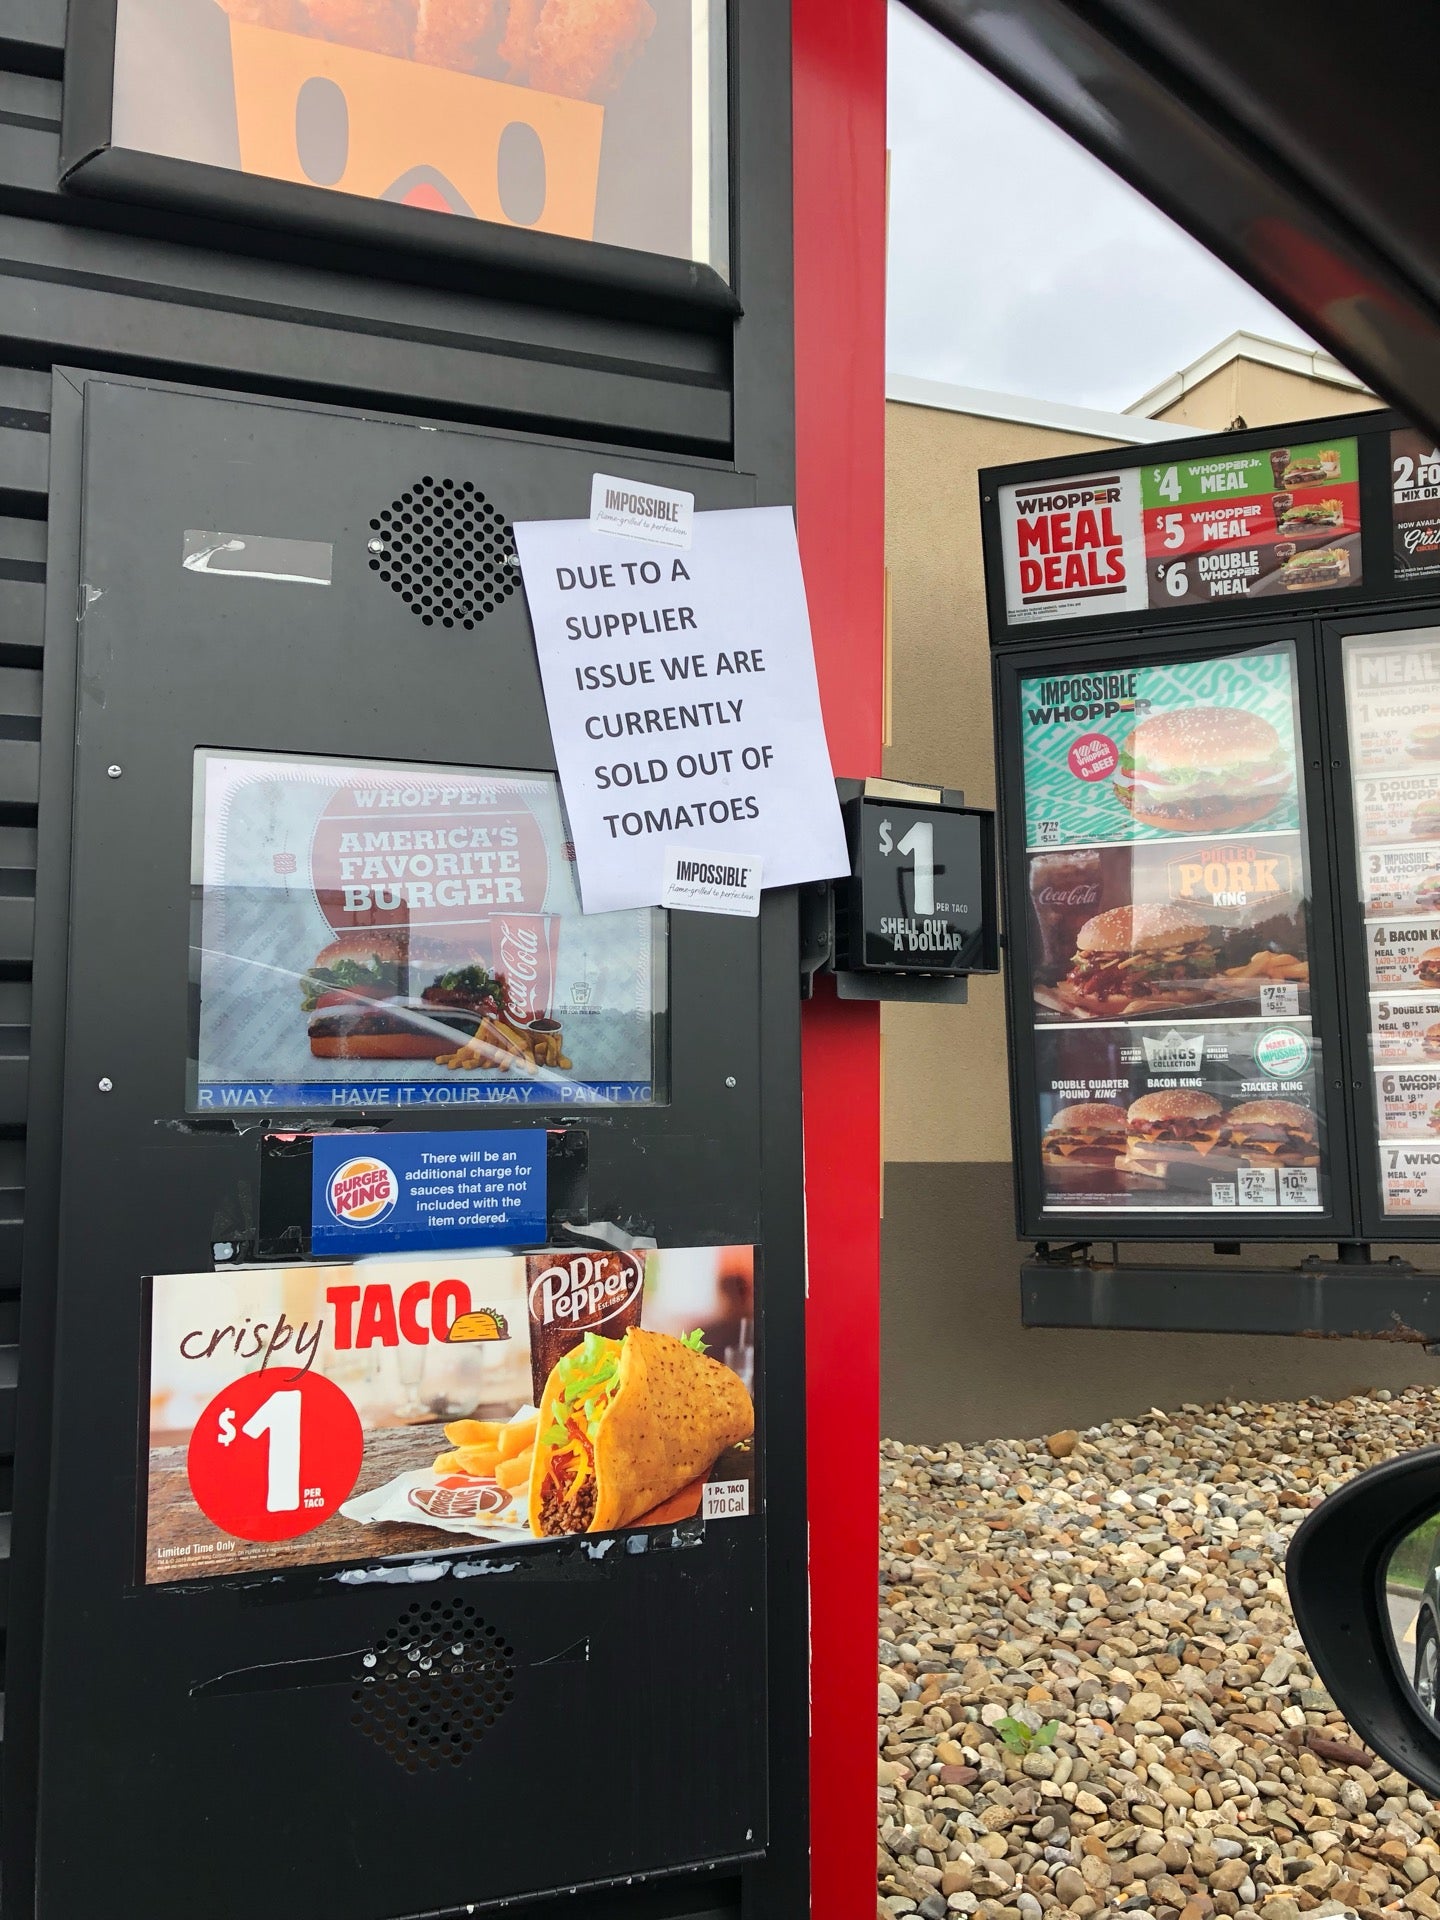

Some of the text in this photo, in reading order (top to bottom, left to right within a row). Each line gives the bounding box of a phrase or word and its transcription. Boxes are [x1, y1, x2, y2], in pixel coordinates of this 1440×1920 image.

[1189, 461, 1248, 477] WHOPPER
[1393, 456, 1414, 490] 2
[1154, 466, 1181, 502] $4
[1200, 471, 1248, 493] MEAL
[1016, 488, 1120, 515] WHOPPER
[1402, 487, 1438, 501] MIX OR
[605, 489, 680, 522] IMPOSSIBLE
[1190, 505, 1262, 524] WHOPPER
[1017, 507, 1122, 558] MEAL
[1156, 512, 1186, 550] $5
[1203, 520, 1251, 541] MEAL
[1398, 521, 1414, 530] NOW
[1020, 548, 1126, 594] DEALS
[1199, 550, 1259, 573] DOUBLE
[556, 558, 690, 590] DUE TO A
[1158, 561, 1189, 597] $6
[1200, 565, 1260, 580] WHOPPER
[1210, 577, 1250, 597] MEAL
[565, 606, 698, 641] SUPPLIER
[575, 649, 766, 691] ISSUE WE ARE
[1040, 673, 1137, 706] IMPOSSIBLE
[584, 699, 744, 740] CURRENTLY
[1028, 699, 1151, 726] WHOPPER
[1374, 704, 1440, 717] WHOPP
[1076, 747, 1111, 766] WHOPPER
[1092, 756, 1114, 773] BEEF
[594, 745, 774, 789] SOLD OUT OF
[1364, 779, 1438, 801] 2 DOUBLE
[603, 796, 760, 839] TOMATOES
[339, 826, 519, 854] AMERICA'S
[339, 851, 521, 881] FAVORITE
[1369, 852, 1429, 874] 3 IMPOSSIBLE
[676, 860, 748, 888] IMPOSSIBLE
[1179, 858, 1280, 897] PORK
[1370, 876, 1388, 884] MEAL
[341, 877, 525, 912] BURGER
[936, 902, 968, 913] PER TACO
[881, 917, 948, 936] SHELL OUT
[893, 933, 963, 952] A DOLLAR
[1374, 927, 1386, 946] 4
[1389, 930, 1427, 942] BACON
[1375, 949, 1394, 957] MEAL
[1392, 974, 1402, 982] Cal
[1378, 1001, 1390, 1020] 5
[1393, 1005, 1424, 1015] DOUBLE
[1379, 1022, 1398, 1030] MEAL
[1152, 1048, 1196, 1060] KING'S
[1153, 1060, 1196, 1068] COLLECTION
[1051, 1078, 1129, 1090] DOUBLE QUARTER
[1147, 1077, 1202, 1088] BACON KING
[1241, 1081, 1303, 1092] STACKER KING
[1382, 1074, 1436, 1095] 6 BACON
[220, 1089, 273, 1107] WAY
[331, 1089, 391, 1105] HAVE
[397, 1088, 412, 1104] IT
[423, 1087, 479, 1104] YOUR
[486, 1087, 533, 1103] WAY
[561, 1087, 600, 1103] PAY
[606, 1087, 622, 1103] IT
[1059, 1088, 1117, 1100] POUND KING
[1384, 1095, 1404, 1103] MEAL
[421, 1151, 517, 1163] There will be an
[1387, 1150, 1399, 1169] 7
[405, 1166, 532, 1181] additional charge for
[1387, 1171, 1408, 1179] MEAL
[334, 1169, 388, 1198] BURGER
[410, 1181, 527, 1196] sauces that are not
[335, 1181, 391, 1216] KING
[417, 1197, 521, 1211] included with the
[428, 1213, 509, 1226] item ordered.
[569, 1257, 608, 1292] Dr
[543, 1267, 634, 1325] Pepper
[180, 1279, 472, 1383] crispy TACO
[304, 1488, 322, 1498] PER
[715, 1487, 725, 1495] Pc.
[728, 1484, 744, 1494] TACO
[303, 1498, 325, 1509] TACO
[708, 1497, 744, 1514] 170 Cal
[158, 1541, 236, 1558] Limited Time Only
